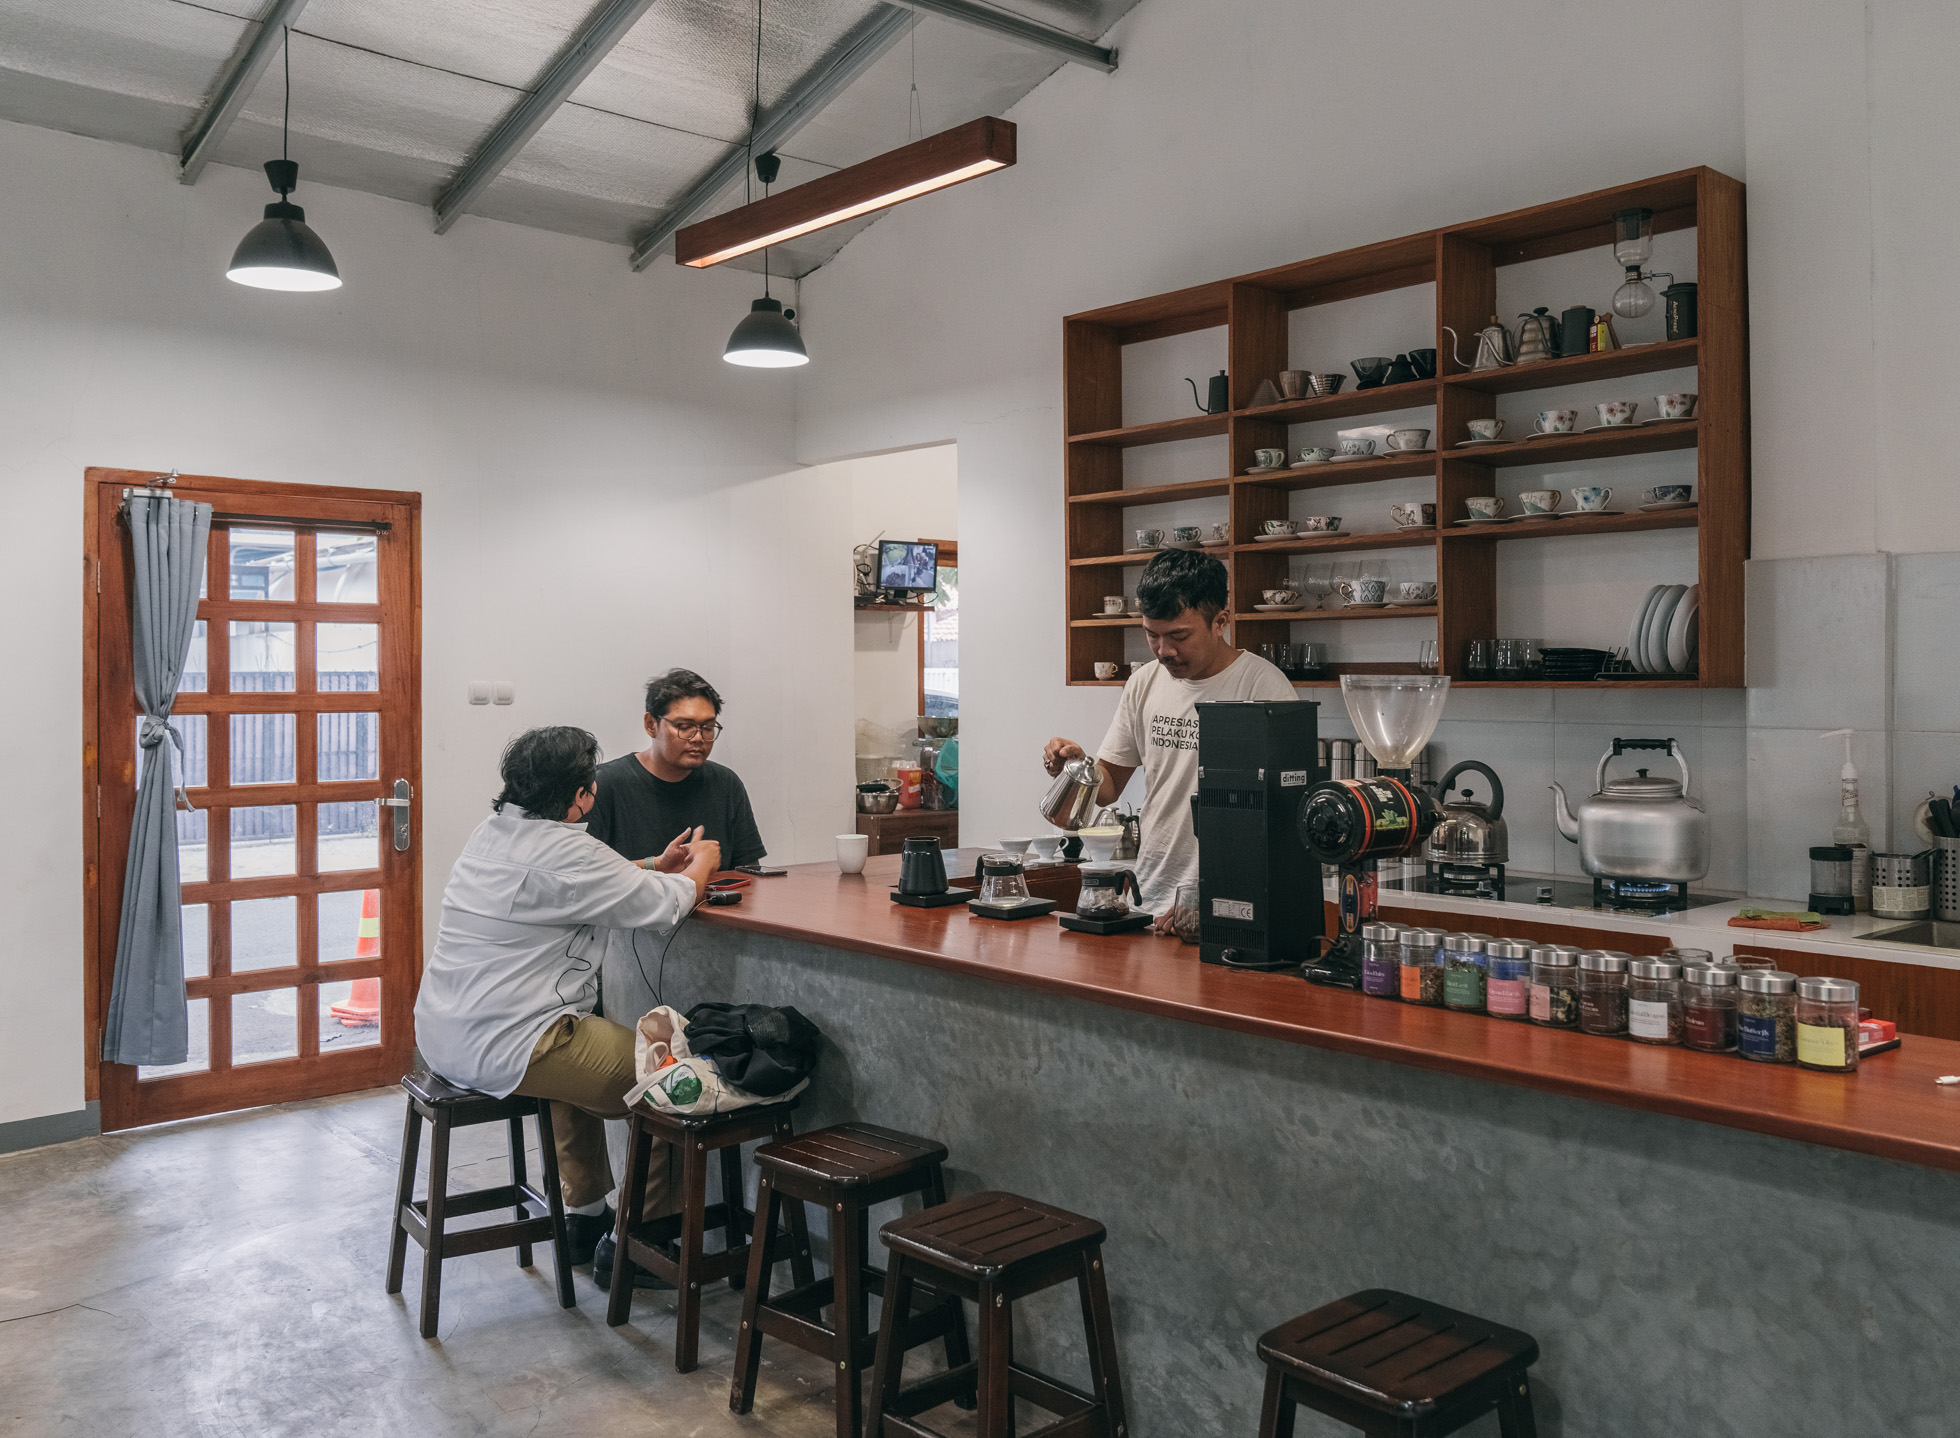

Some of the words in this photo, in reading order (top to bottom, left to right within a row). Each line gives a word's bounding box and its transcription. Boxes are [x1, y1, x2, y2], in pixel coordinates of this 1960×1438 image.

[1152, 714, 1199, 729] APRESIAS
[1151, 725, 1188, 739] PELAKU
[1188, 730, 1200, 740] KO
[1151, 737, 1199, 751] INDONESIA
[1282, 773, 1305, 784] ditting
